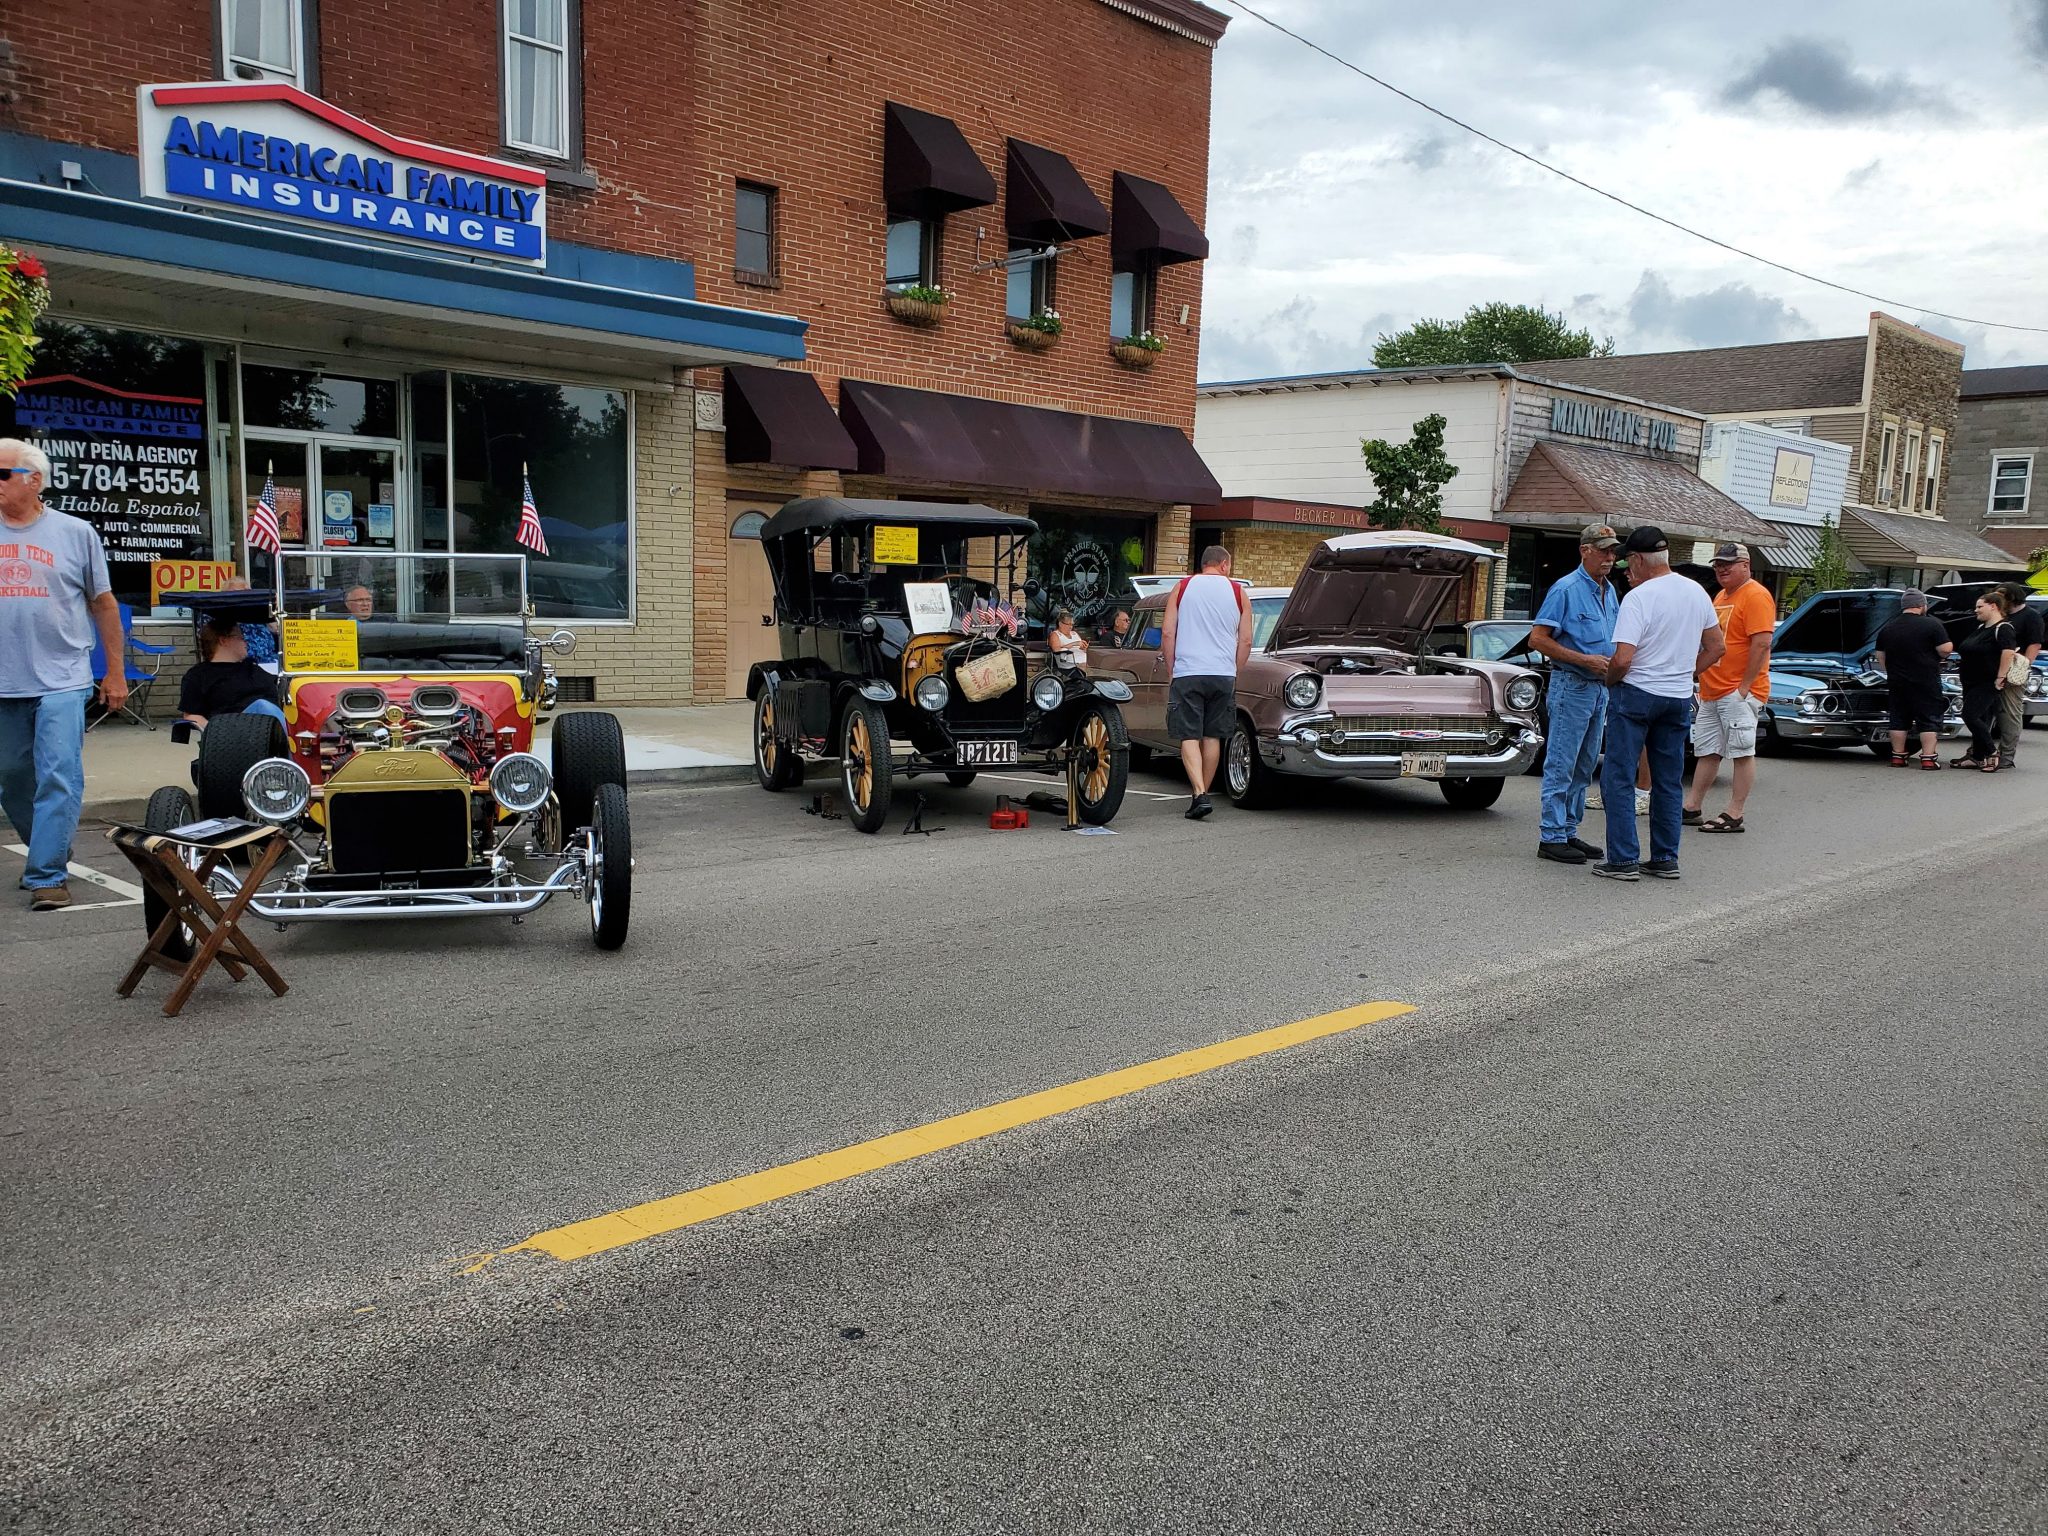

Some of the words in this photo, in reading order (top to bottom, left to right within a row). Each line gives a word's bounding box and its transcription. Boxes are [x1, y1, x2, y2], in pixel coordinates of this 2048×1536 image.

[164, 116, 393, 194] AMERICAN
[406, 167, 540, 222] FAMILY
[204, 168, 515, 247] INSURANCE
[16, 393, 124, 415] AMERICAN
[132, 402, 200, 422] FAMILY
[1551, 398, 1643, 446] MINNIHANS
[1648, 419, 1677, 452] PUB
[90, 439, 134, 462] PEÑA
[136, 445, 198, 465] AGENCY
[1776, 475, 1809, 489] REFLECTIONS
[58, 495, 120, 514] Habla
[125, 499, 201, 518] Español
[1294, 507, 1336, 524] BECKER
[1342, 513, 1362, 526] LAW
[104, 521, 130, 532] AUTO
[140, 522, 202, 535] COMMERCIAL
[323, 526, 344, 535] CLOSED
[121, 537, 183, 549] FARM/RANCH
[26, 544, 54, 568] TECH
[114, 552, 161, 562] BUSINESS
[1063, 541, 1091, 566] PRAIRIE
[1091, 542, 1110, 567] STATE
[156, 564, 233, 590] OPEN
[1089, 599, 1106, 615] CLUB
[375, 757, 417, 776] Ford
[1402, 759, 1414, 772] 57
[1418, 760, 1439, 772] NMAD
